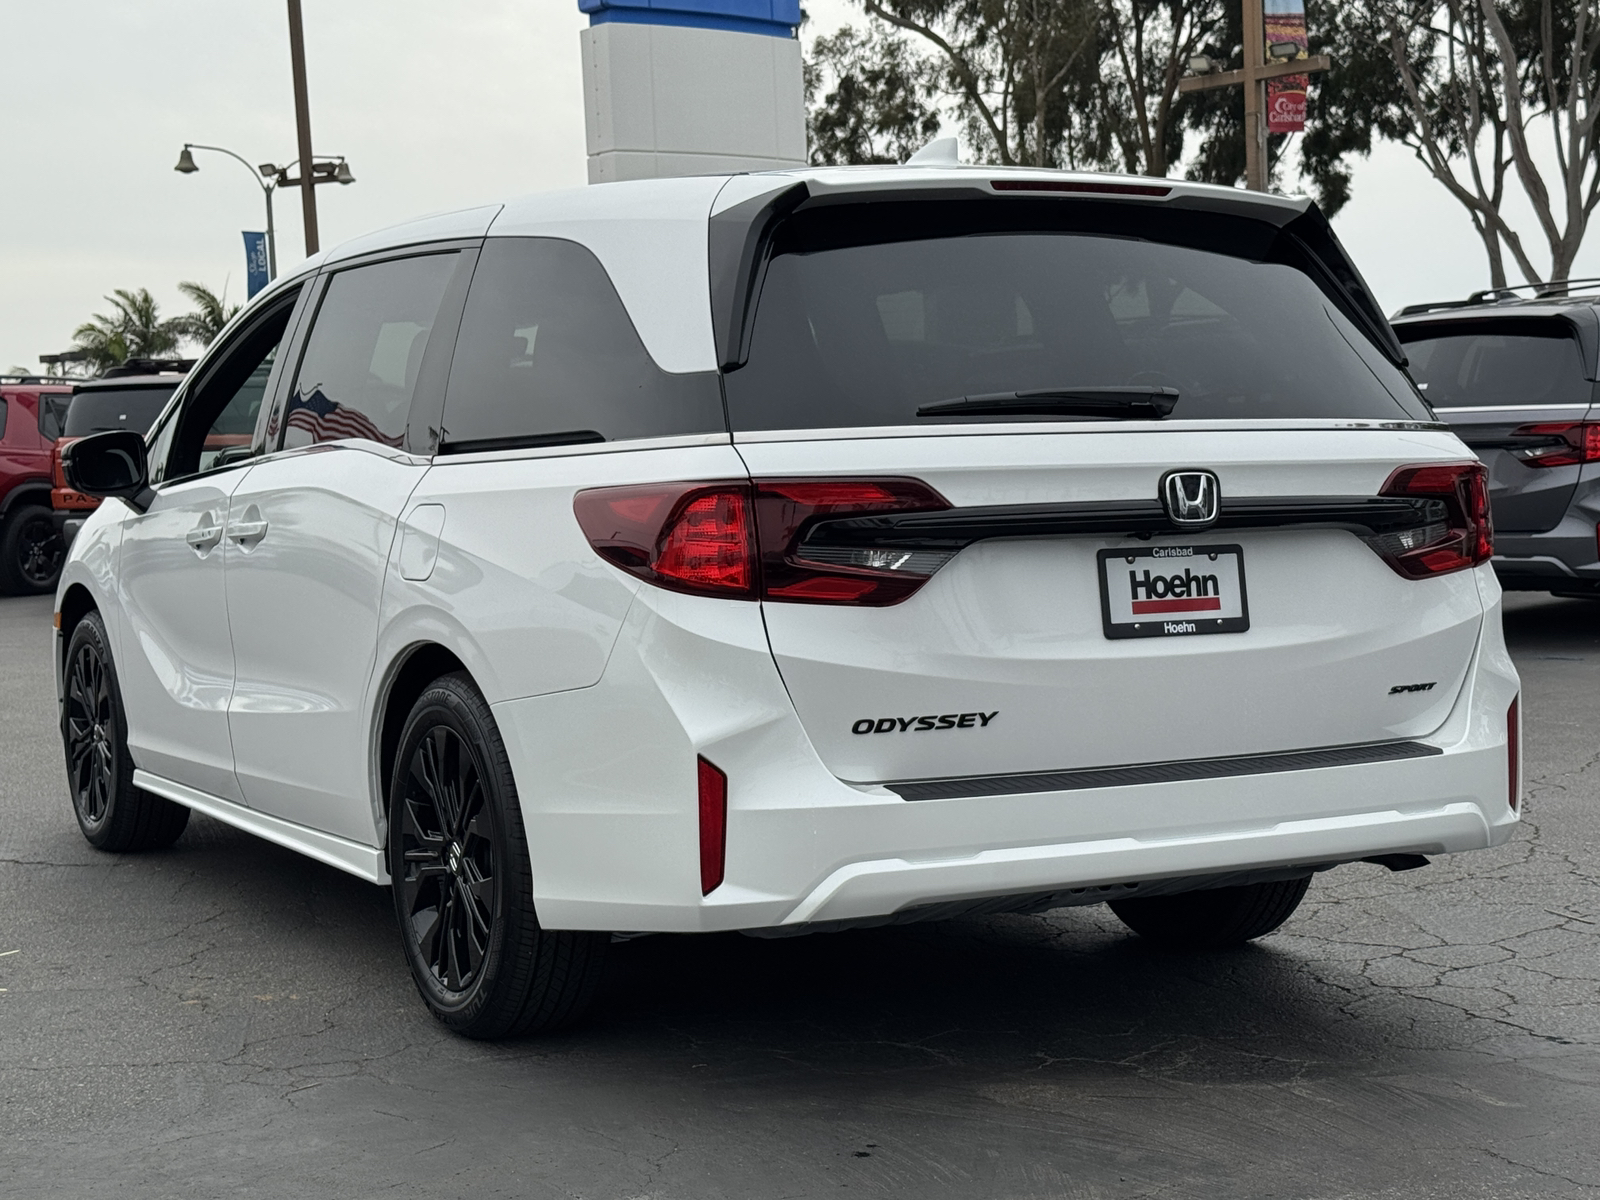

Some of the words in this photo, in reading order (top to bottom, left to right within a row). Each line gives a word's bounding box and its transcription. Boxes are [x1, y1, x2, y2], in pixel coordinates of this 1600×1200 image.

[256, 237, 267, 272] LOCAL
[1152, 547, 1194, 558] Carlsbad
[1129, 568, 1220, 600] Hoehn
[1164, 622, 1196, 634] Hoehn
[1388, 681, 1437, 695] SPORT
[851, 710, 1000, 735] ODYSSEY
